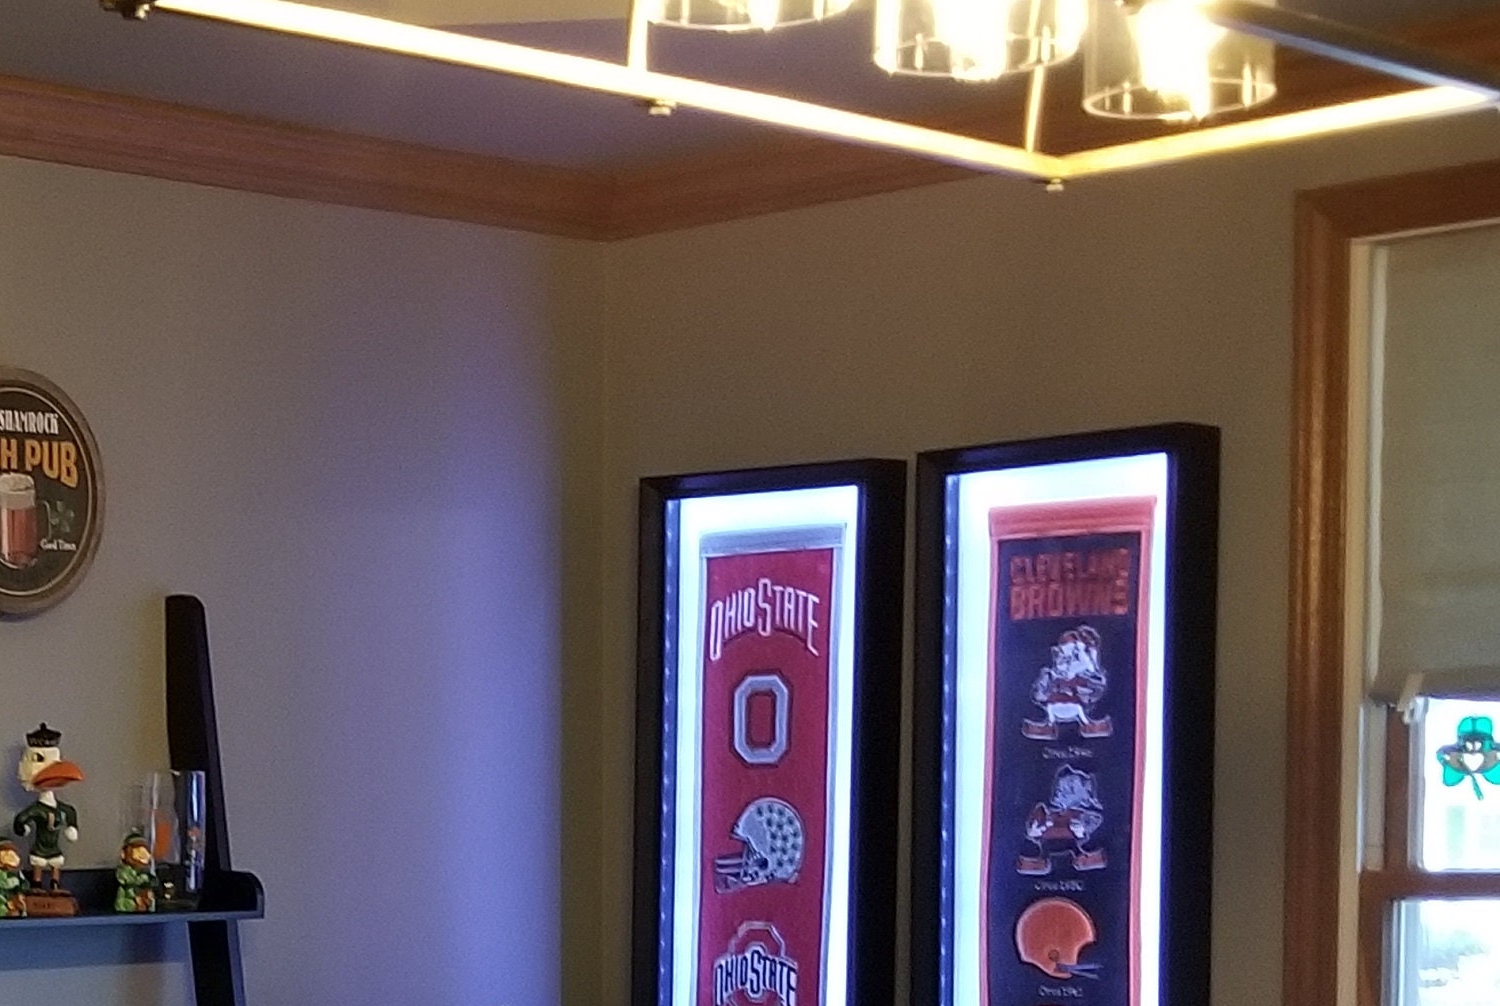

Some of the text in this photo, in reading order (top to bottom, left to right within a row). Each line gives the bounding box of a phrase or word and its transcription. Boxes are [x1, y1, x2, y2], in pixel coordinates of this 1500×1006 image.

[0, 409, 60, 435] SHAMROCK
[25, 439, 79, 488] PUB
[1010, 581, 1128, 621] BROWNS
[733, 673, 789, 764] O
